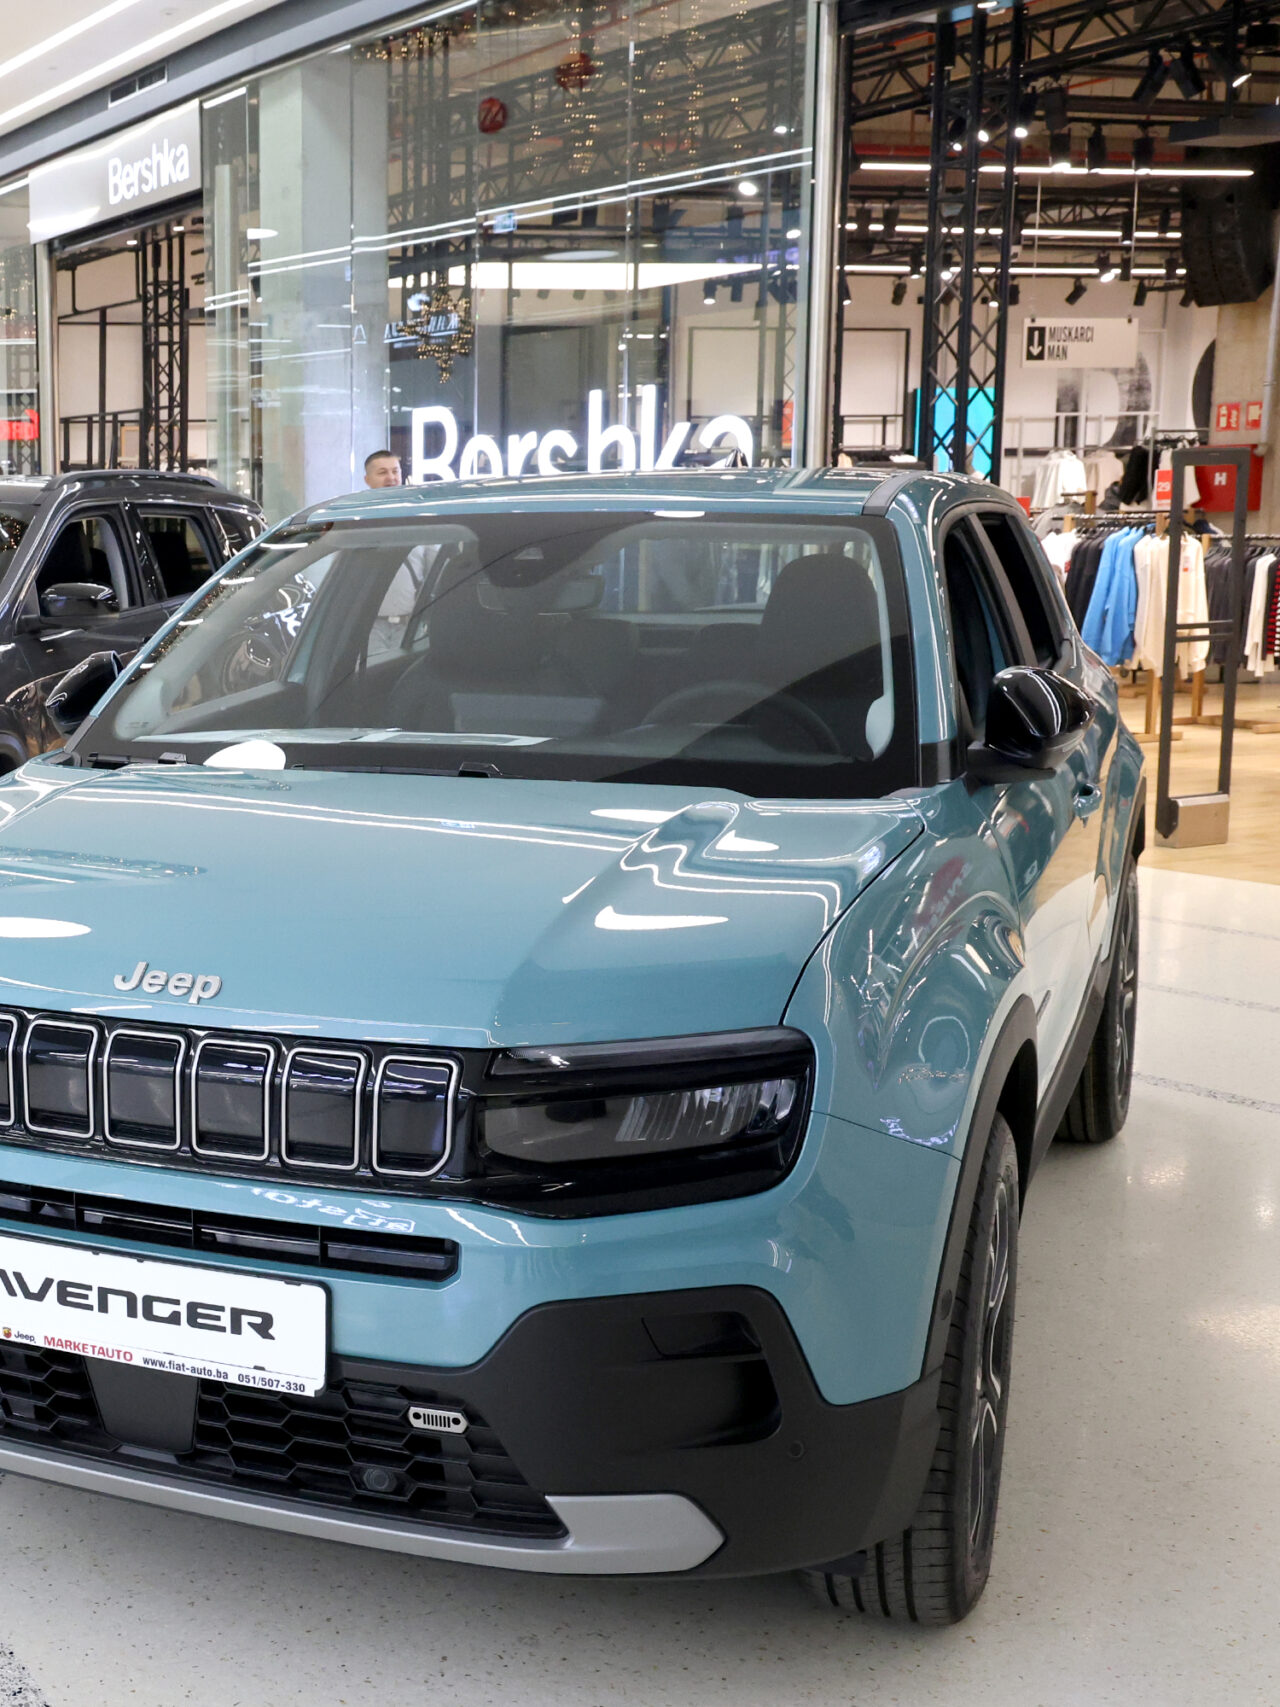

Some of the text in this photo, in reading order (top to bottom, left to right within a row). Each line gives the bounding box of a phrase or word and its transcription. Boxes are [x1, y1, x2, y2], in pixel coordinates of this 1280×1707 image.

[108, 138, 190, 205] Bershka
[1048, 325, 1095, 343] MUSKARCI
[1047, 344, 1068, 361] MAN
[1214, 472, 1227, 486] H
[113, 961, 222, 1004] Jeep
[43, 1335, 133, 1362] MARKETAUTO
[142, 1357, 229, 1380] www.fiat-auto.ba
[237, 1373, 306, 1393] 051/507-330
